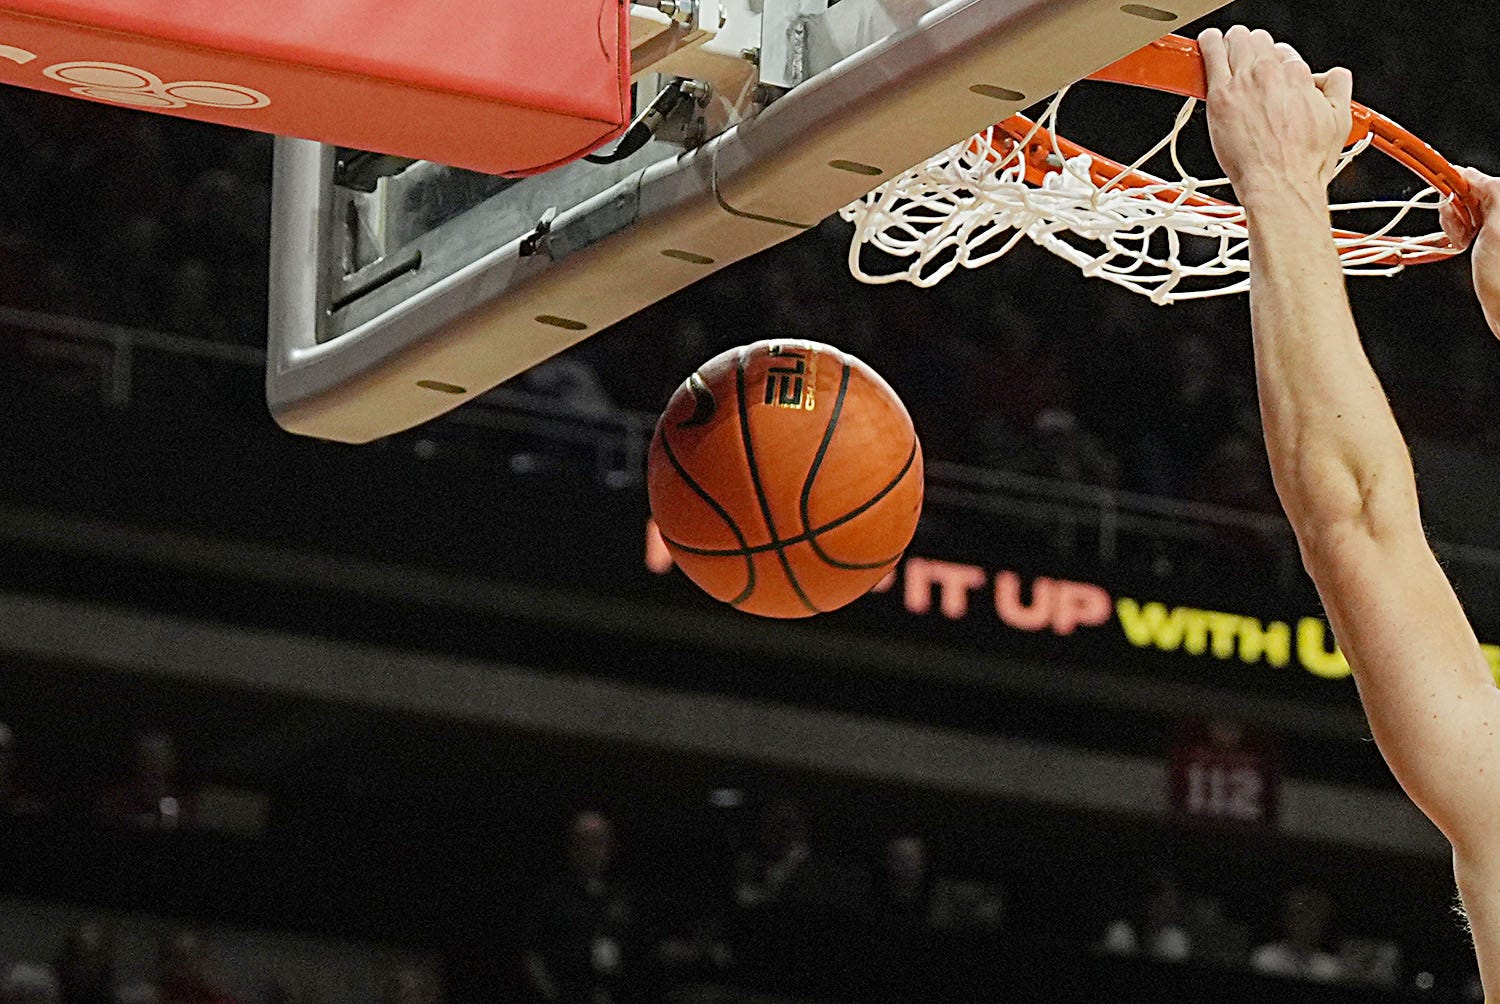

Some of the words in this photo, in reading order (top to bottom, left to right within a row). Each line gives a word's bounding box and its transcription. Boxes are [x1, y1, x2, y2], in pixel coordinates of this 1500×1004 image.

[904, 556, 986, 620] IT
[995, 569, 1111, 636] UP
[1116, 597, 1292, 668] WITH
